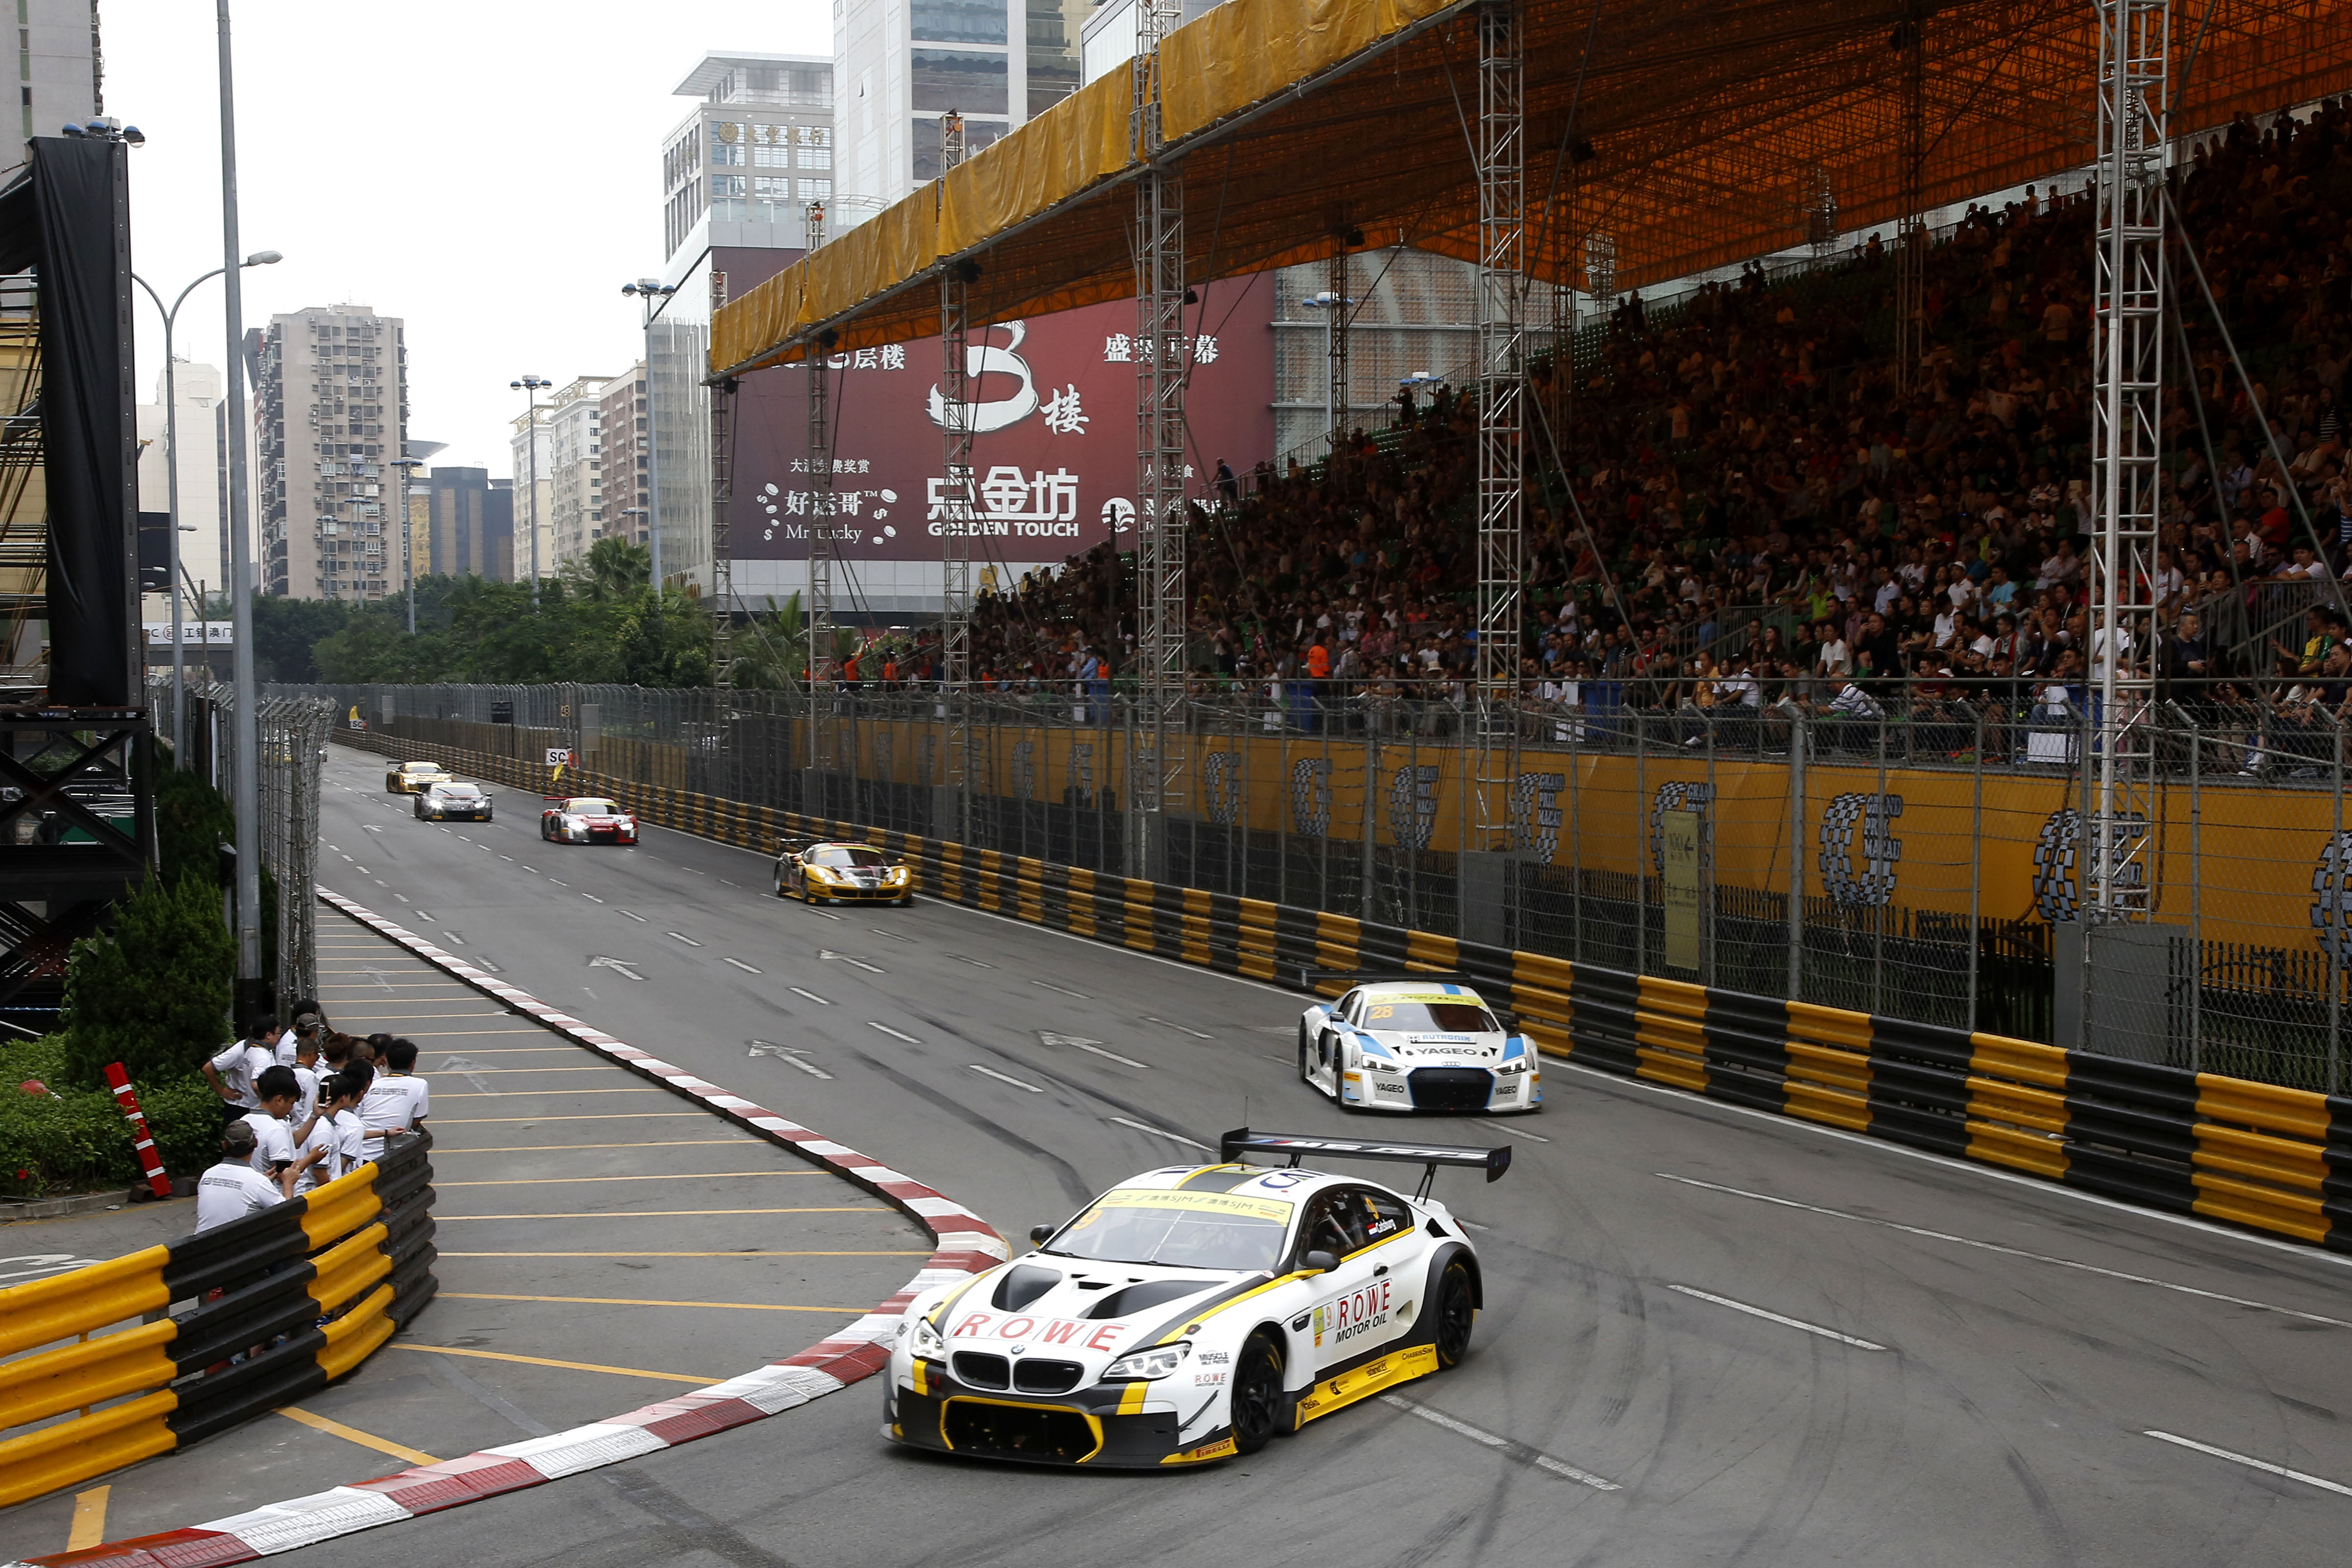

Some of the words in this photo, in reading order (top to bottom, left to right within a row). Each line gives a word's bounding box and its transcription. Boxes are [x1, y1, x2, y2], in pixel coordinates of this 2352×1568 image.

[928, 522, 1009, 537] GOLDEN
[1014, 522, 1079, 537] TOUCH
[550, 752, 565, 762] SC
[1370, 1005, 1394, 1020] 28
[1375, 1082, 1404, 1093] YAGEO
[1495, 1085, 1517, 1095] YAGEO
[1365, 1197, 1379, 1220] 9
[1072, 1209, 1102, 1230] 9
[1326, 1306, 1332, 1326] 9
[1337, 1282, 1391, 1331] ROWE
[954, 1314, 1125, 1352] ROWE
[1335, 1319, 1370, 1345] MOTOR
[1372, 1312, 1387, 1328] OIL
[1195, 1372, 1227, 1383] ROWE
[1196, 1439, 1230, 1458] PIRELLI
